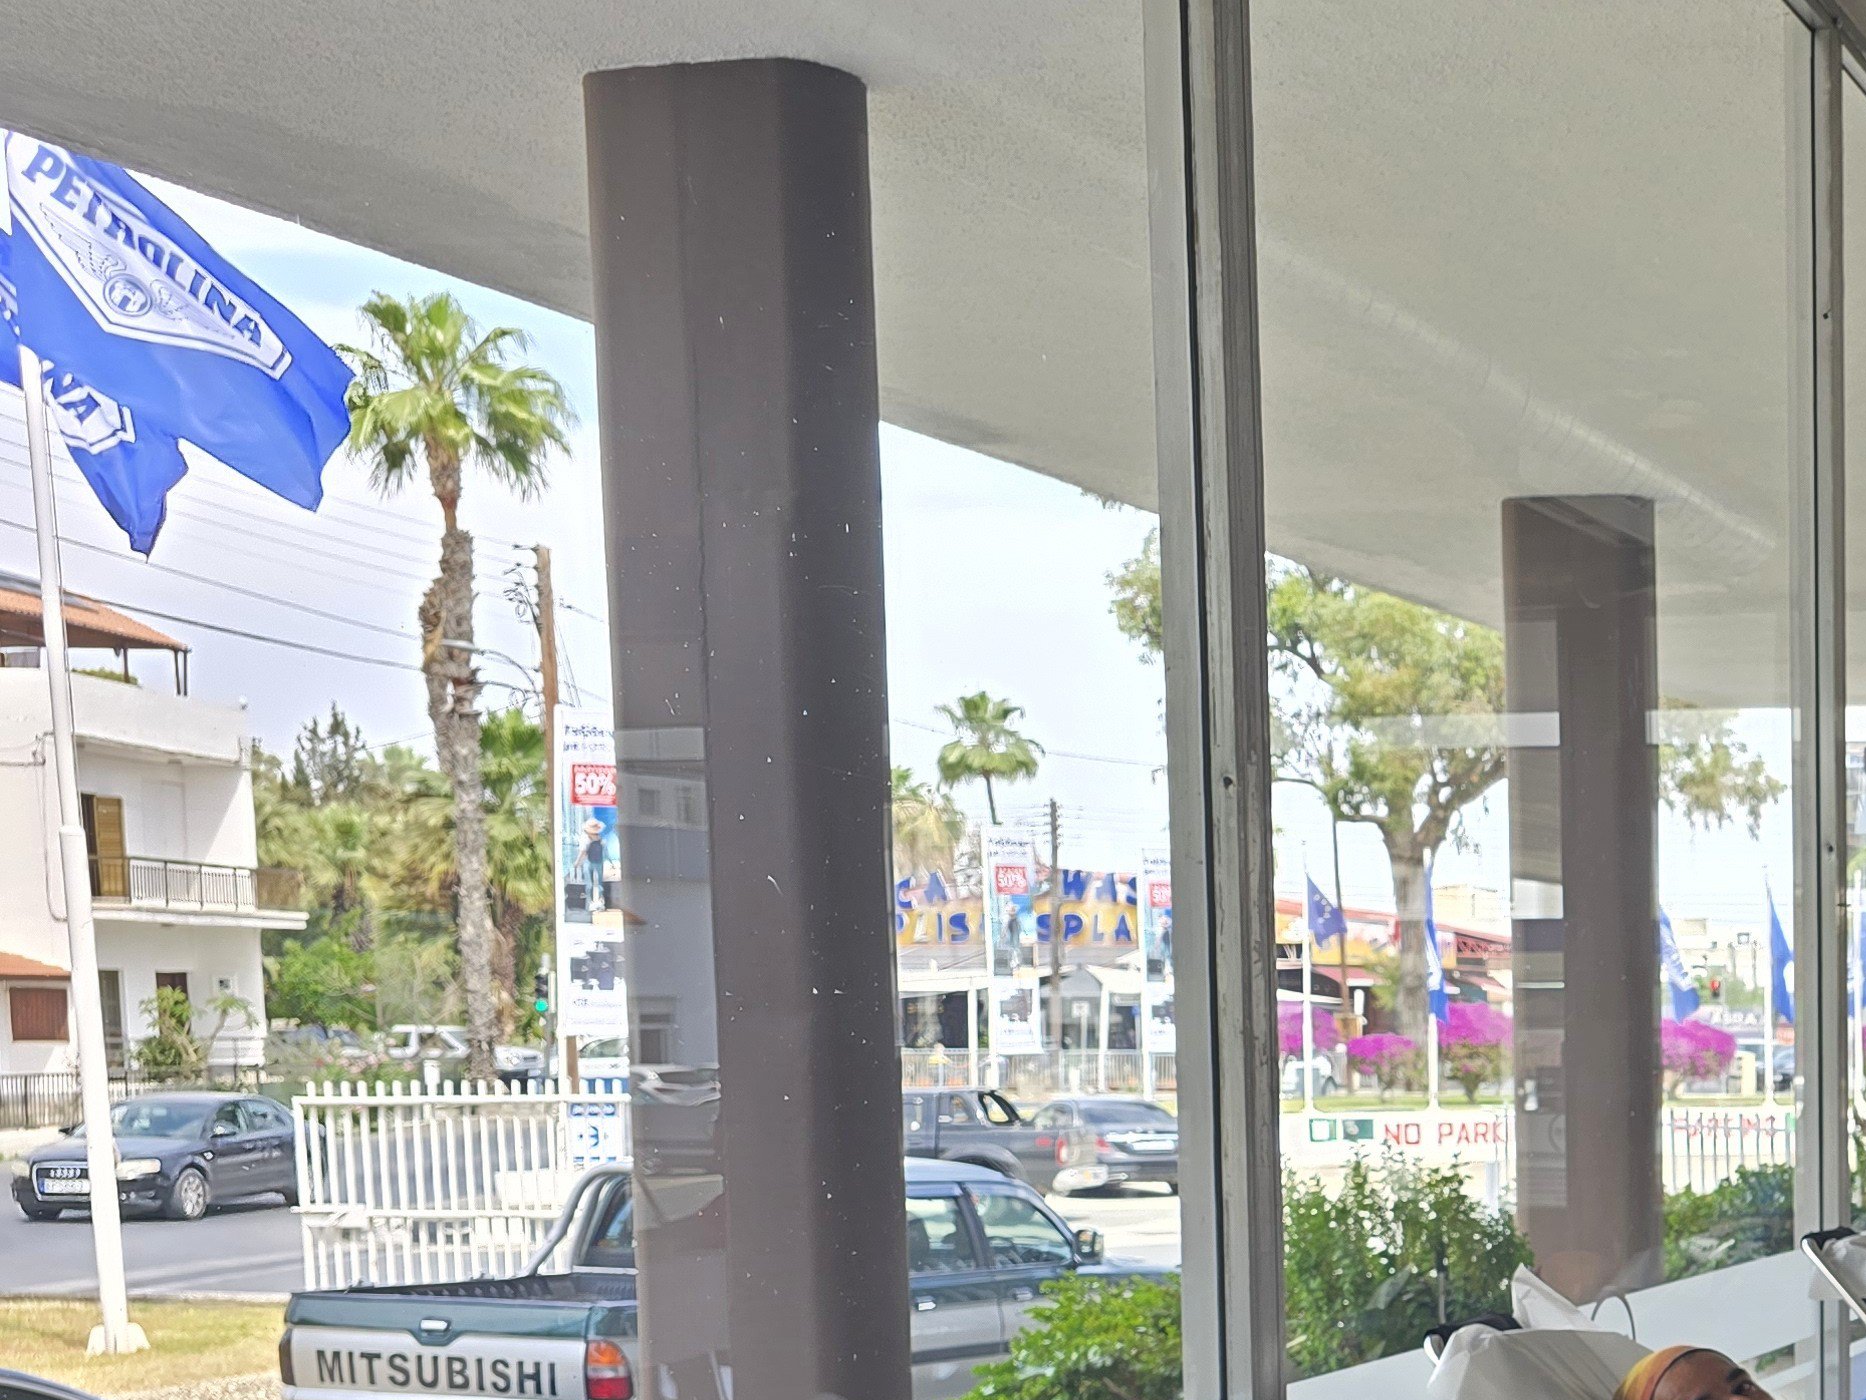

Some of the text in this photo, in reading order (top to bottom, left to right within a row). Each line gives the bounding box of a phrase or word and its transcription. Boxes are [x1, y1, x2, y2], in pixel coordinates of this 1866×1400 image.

[20, 143, 265, 349] PETROLINA
[1384, 1122, 1421, 1146] NO
[316, 1348, 558, 1398] MITSUBISHI
